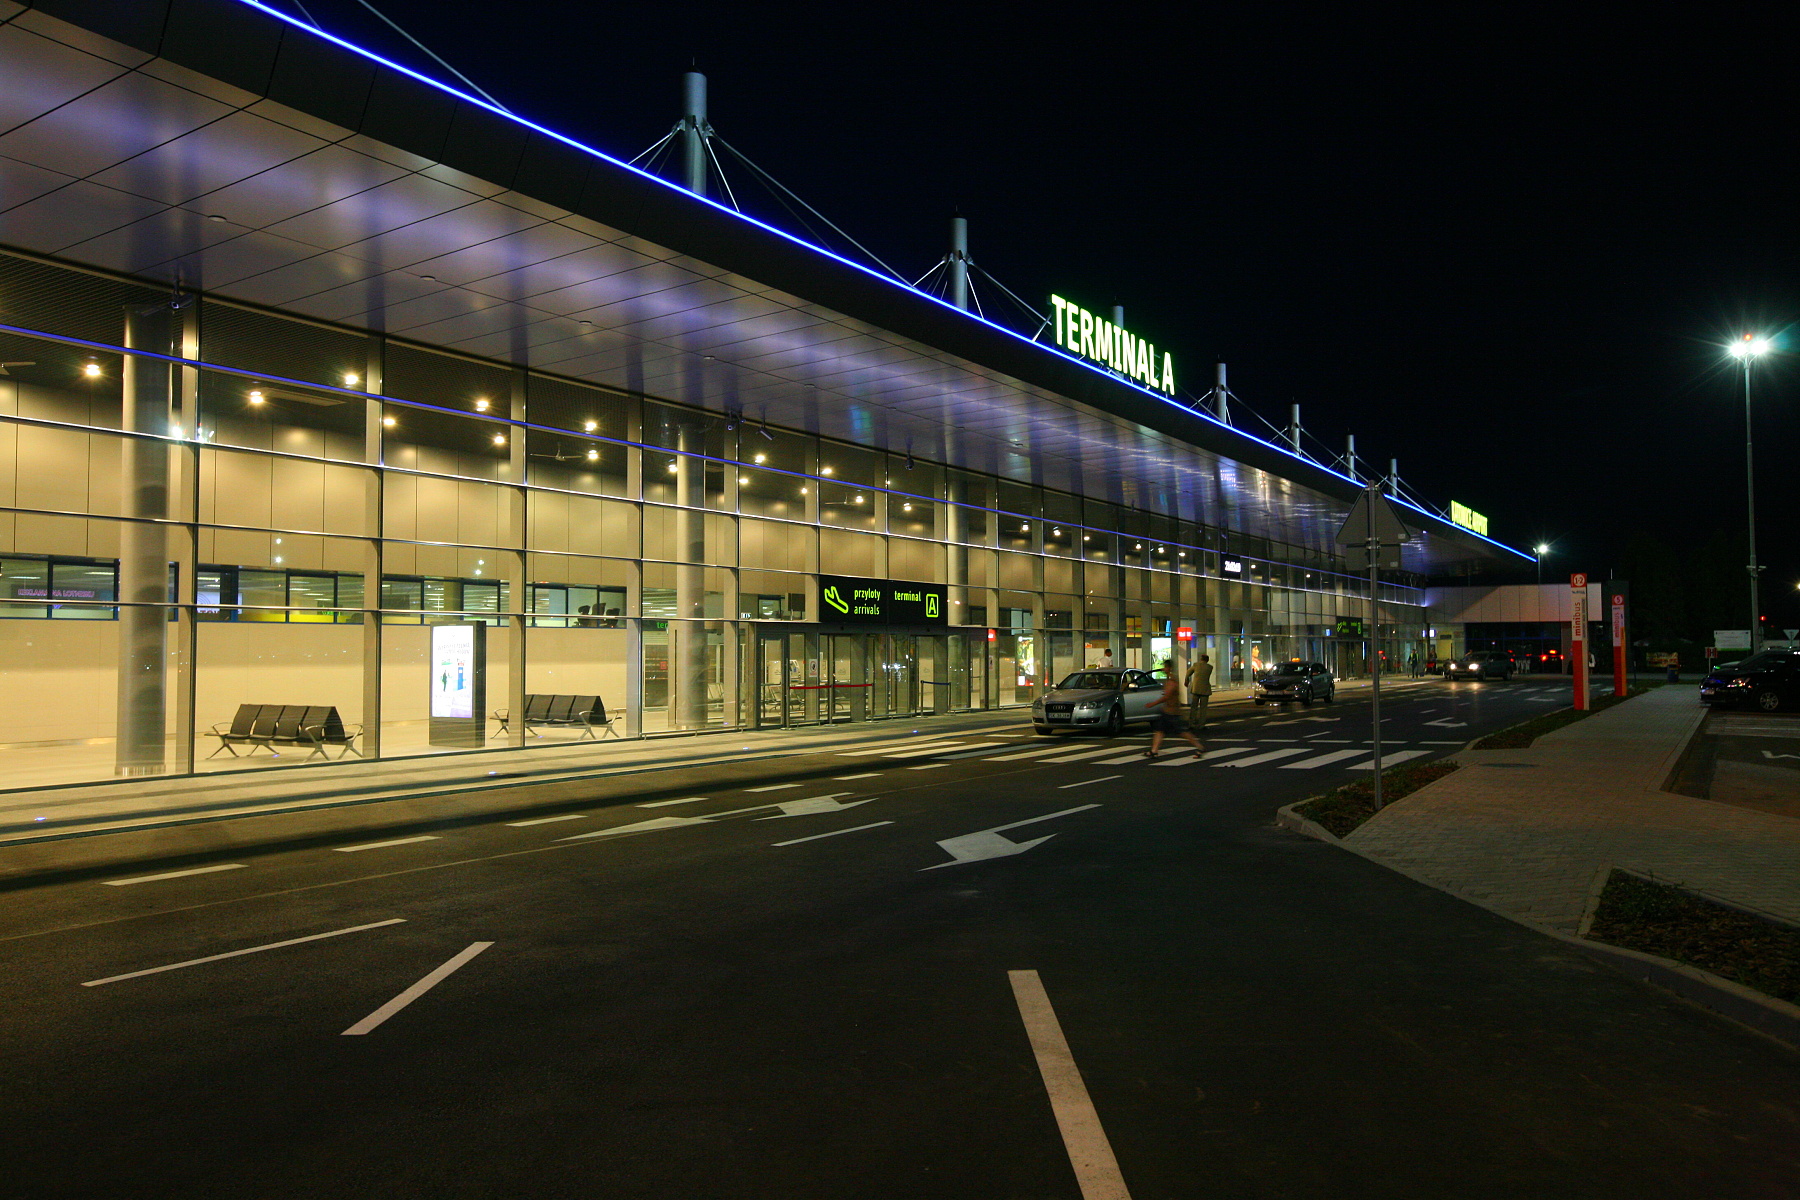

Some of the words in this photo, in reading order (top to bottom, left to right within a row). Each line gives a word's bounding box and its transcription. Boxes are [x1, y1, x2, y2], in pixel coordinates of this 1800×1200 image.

[1051, 294, 1160, 389] TERMINAL
[1162, 352, 1175, 395] A
[854, 588, 880, 601] przyloty
[894, 591, 921, 601] terminal
[854, 603, 880, 615] arrivals
[928, 597, 937, 615] A
[1573, 602, 1581, 636] minibus
